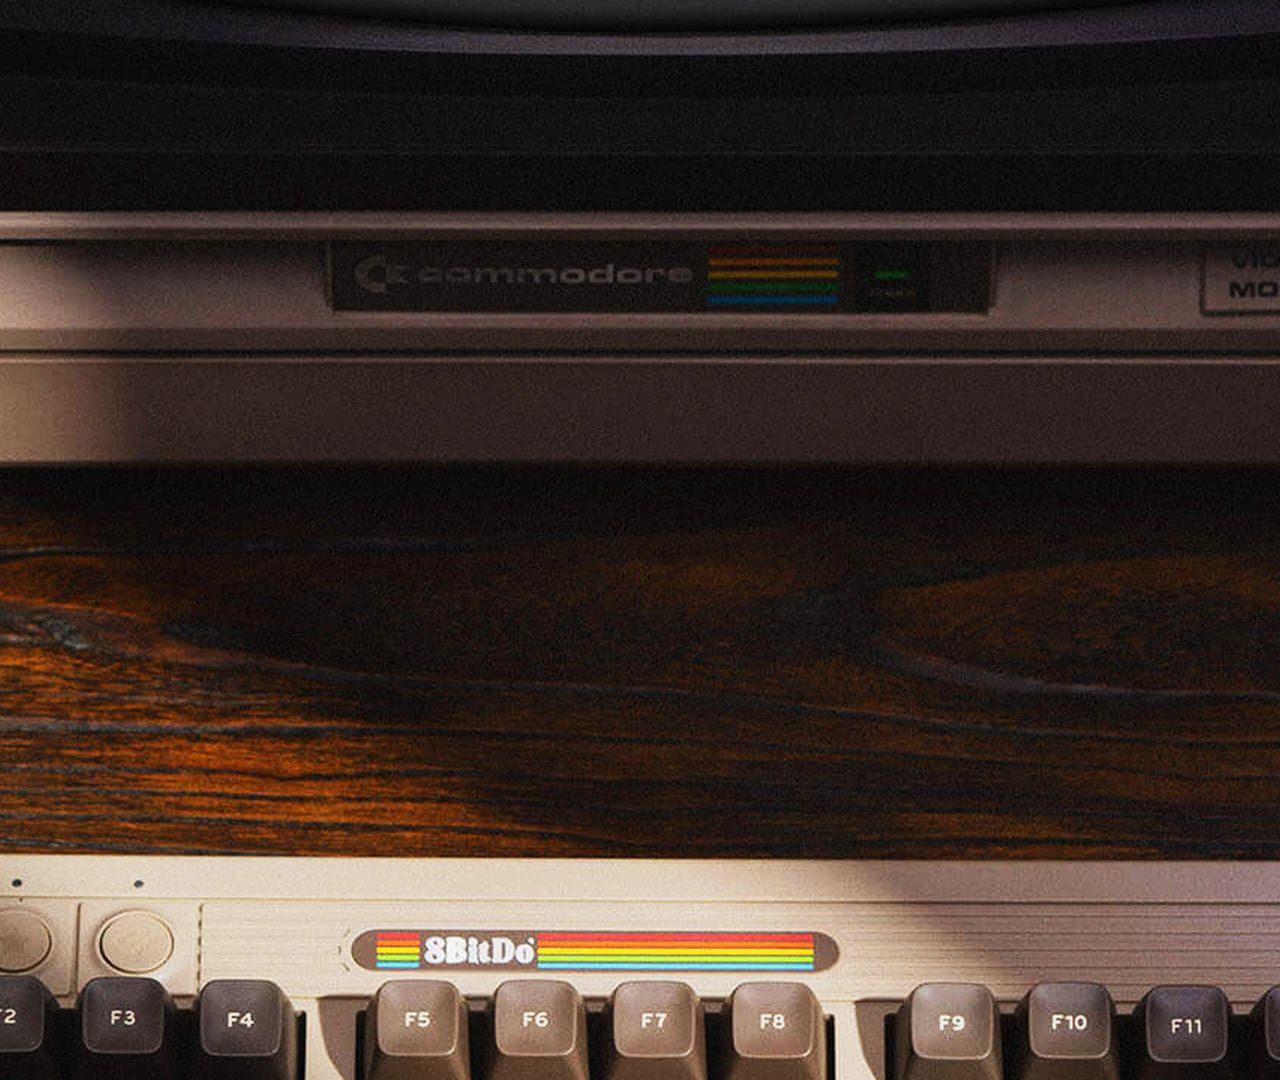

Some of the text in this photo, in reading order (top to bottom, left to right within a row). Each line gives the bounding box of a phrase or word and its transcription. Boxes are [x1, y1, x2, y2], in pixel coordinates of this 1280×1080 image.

[418, 262, 695, 286] commodore
[424, 936, 535, 966] 8BitDo
[110, 1009, 136, 1026] F3
[227, 1012, 255, 1028] F4
[404, 1011, 431, 1028] F5
[522, 1011, 549, 1028] F6
[641, 1012, 667, 1028] F7
[759, 1013, 786, 1030] F8
[938, 1014, 966, 1032] F9
[1051, 1014, 1087, 1030] F10
[1171, 1018, 1202, 1034] F11
